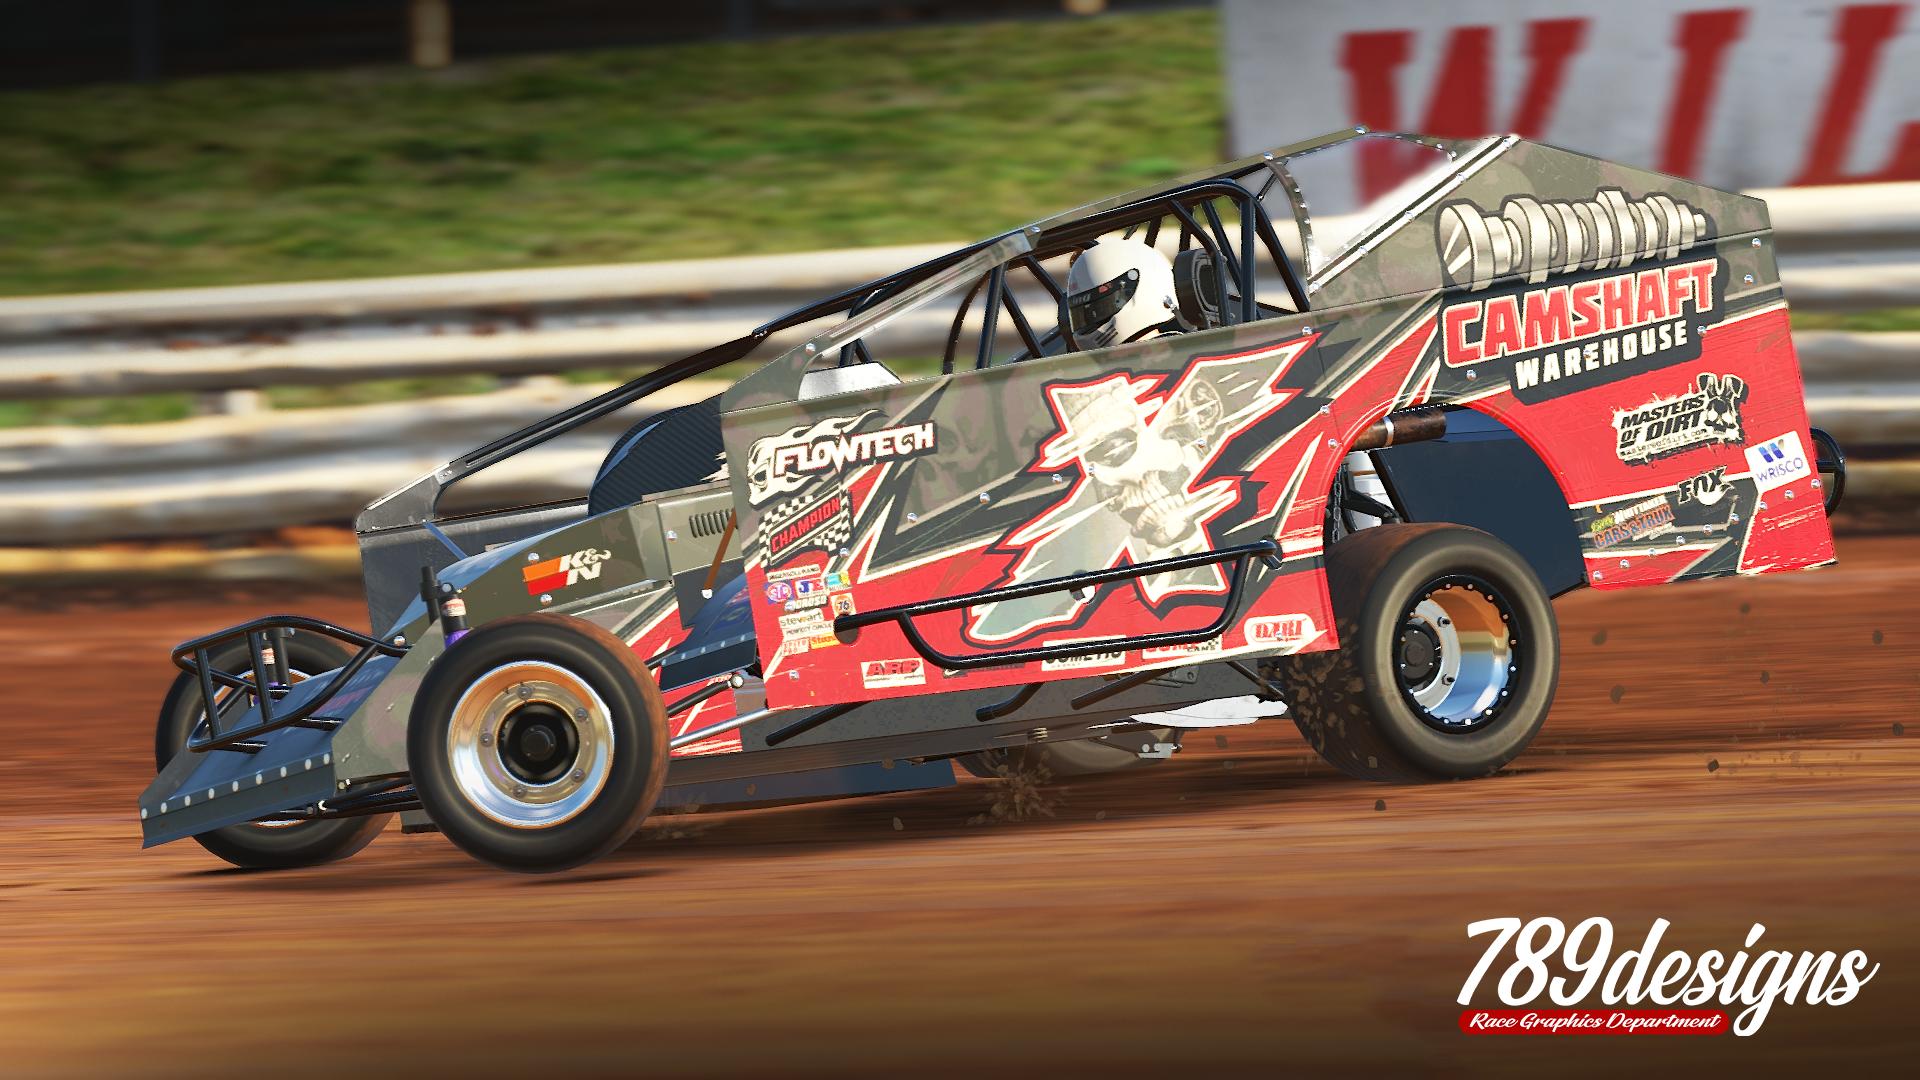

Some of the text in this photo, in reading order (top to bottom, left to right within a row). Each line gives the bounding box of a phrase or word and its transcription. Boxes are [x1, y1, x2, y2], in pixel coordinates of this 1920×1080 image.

[1442, 258, 1718, 368] CAMSHAFT
[1515, 320, 1688, 390] WAREHOUSE
[1620, 394, 1705, 429] MASTERS
[1620, 409, 1704, 443] OF DIRT
[773, 422, 936, 473] FLOWTECH
[1678, 466, 1728, 504] FOX
[1756, 457, 1804, 482] WRISCO
[771, 497, 840, 552] CHAMPION
[559, 548, 611, 586] K&N
[769, 583, 790, 599] STP
[839, 601, 850, 610] 76
[866, 660, 920, 676] ARP
